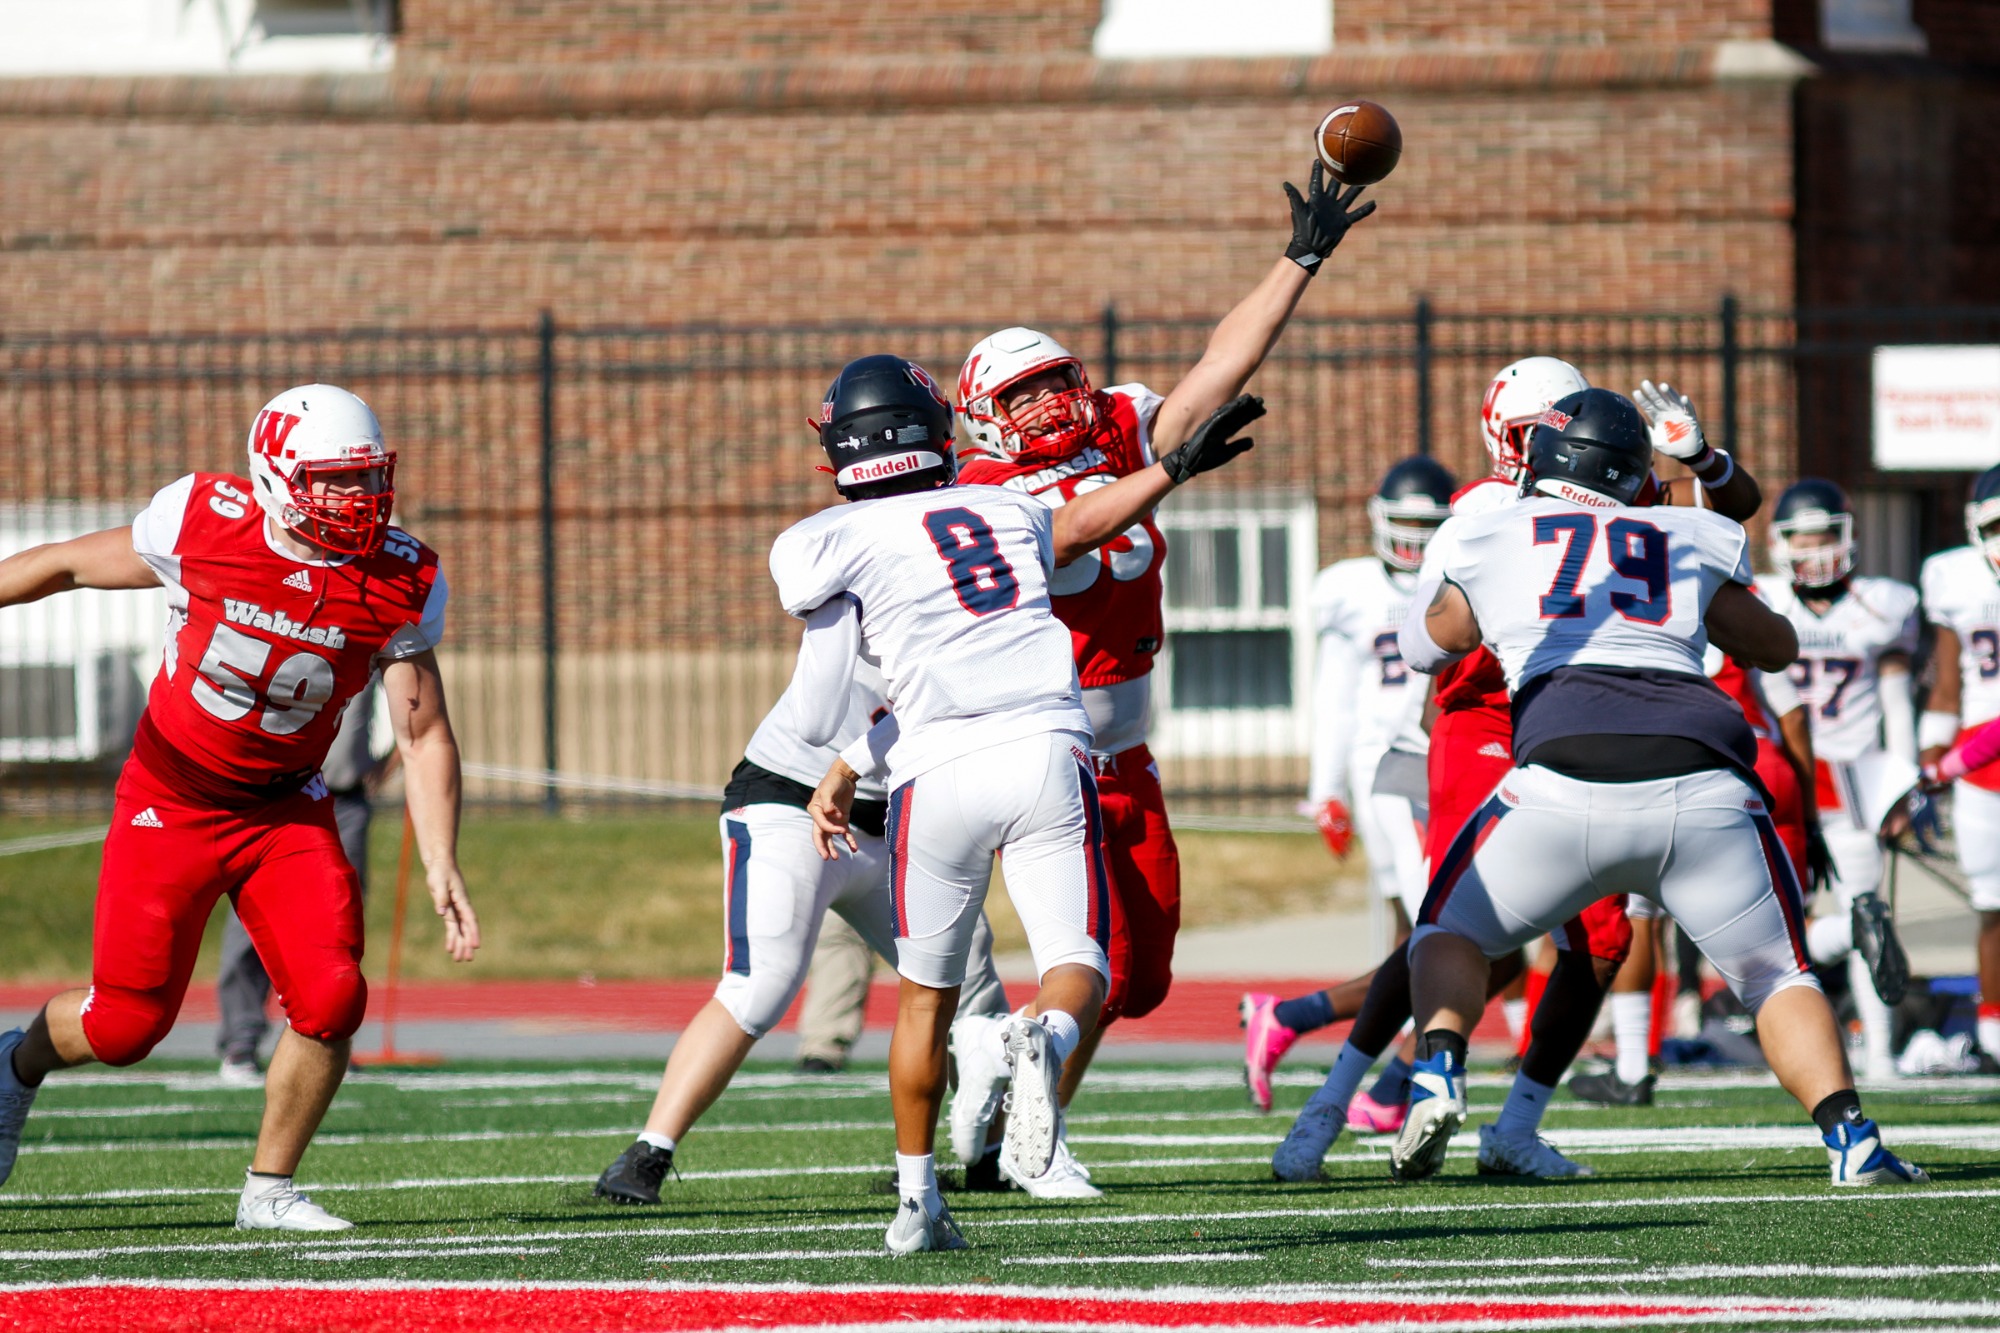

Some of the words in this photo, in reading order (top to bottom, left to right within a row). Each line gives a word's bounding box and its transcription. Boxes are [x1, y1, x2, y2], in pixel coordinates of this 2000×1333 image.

[851, 455, 920, 481] Riddell
[209, 480, 249, 519] 59
[383, 529, 420, 565] 59
[922, 506, 1021, 617] 8
[282, 577, 313, 593] adidas
[1532, 512, 1672, 627] 79
[223, 597, 347, 649] Wabash
[190, 622, 335, 736] 59
[131, 818, 164, 829] adidas
